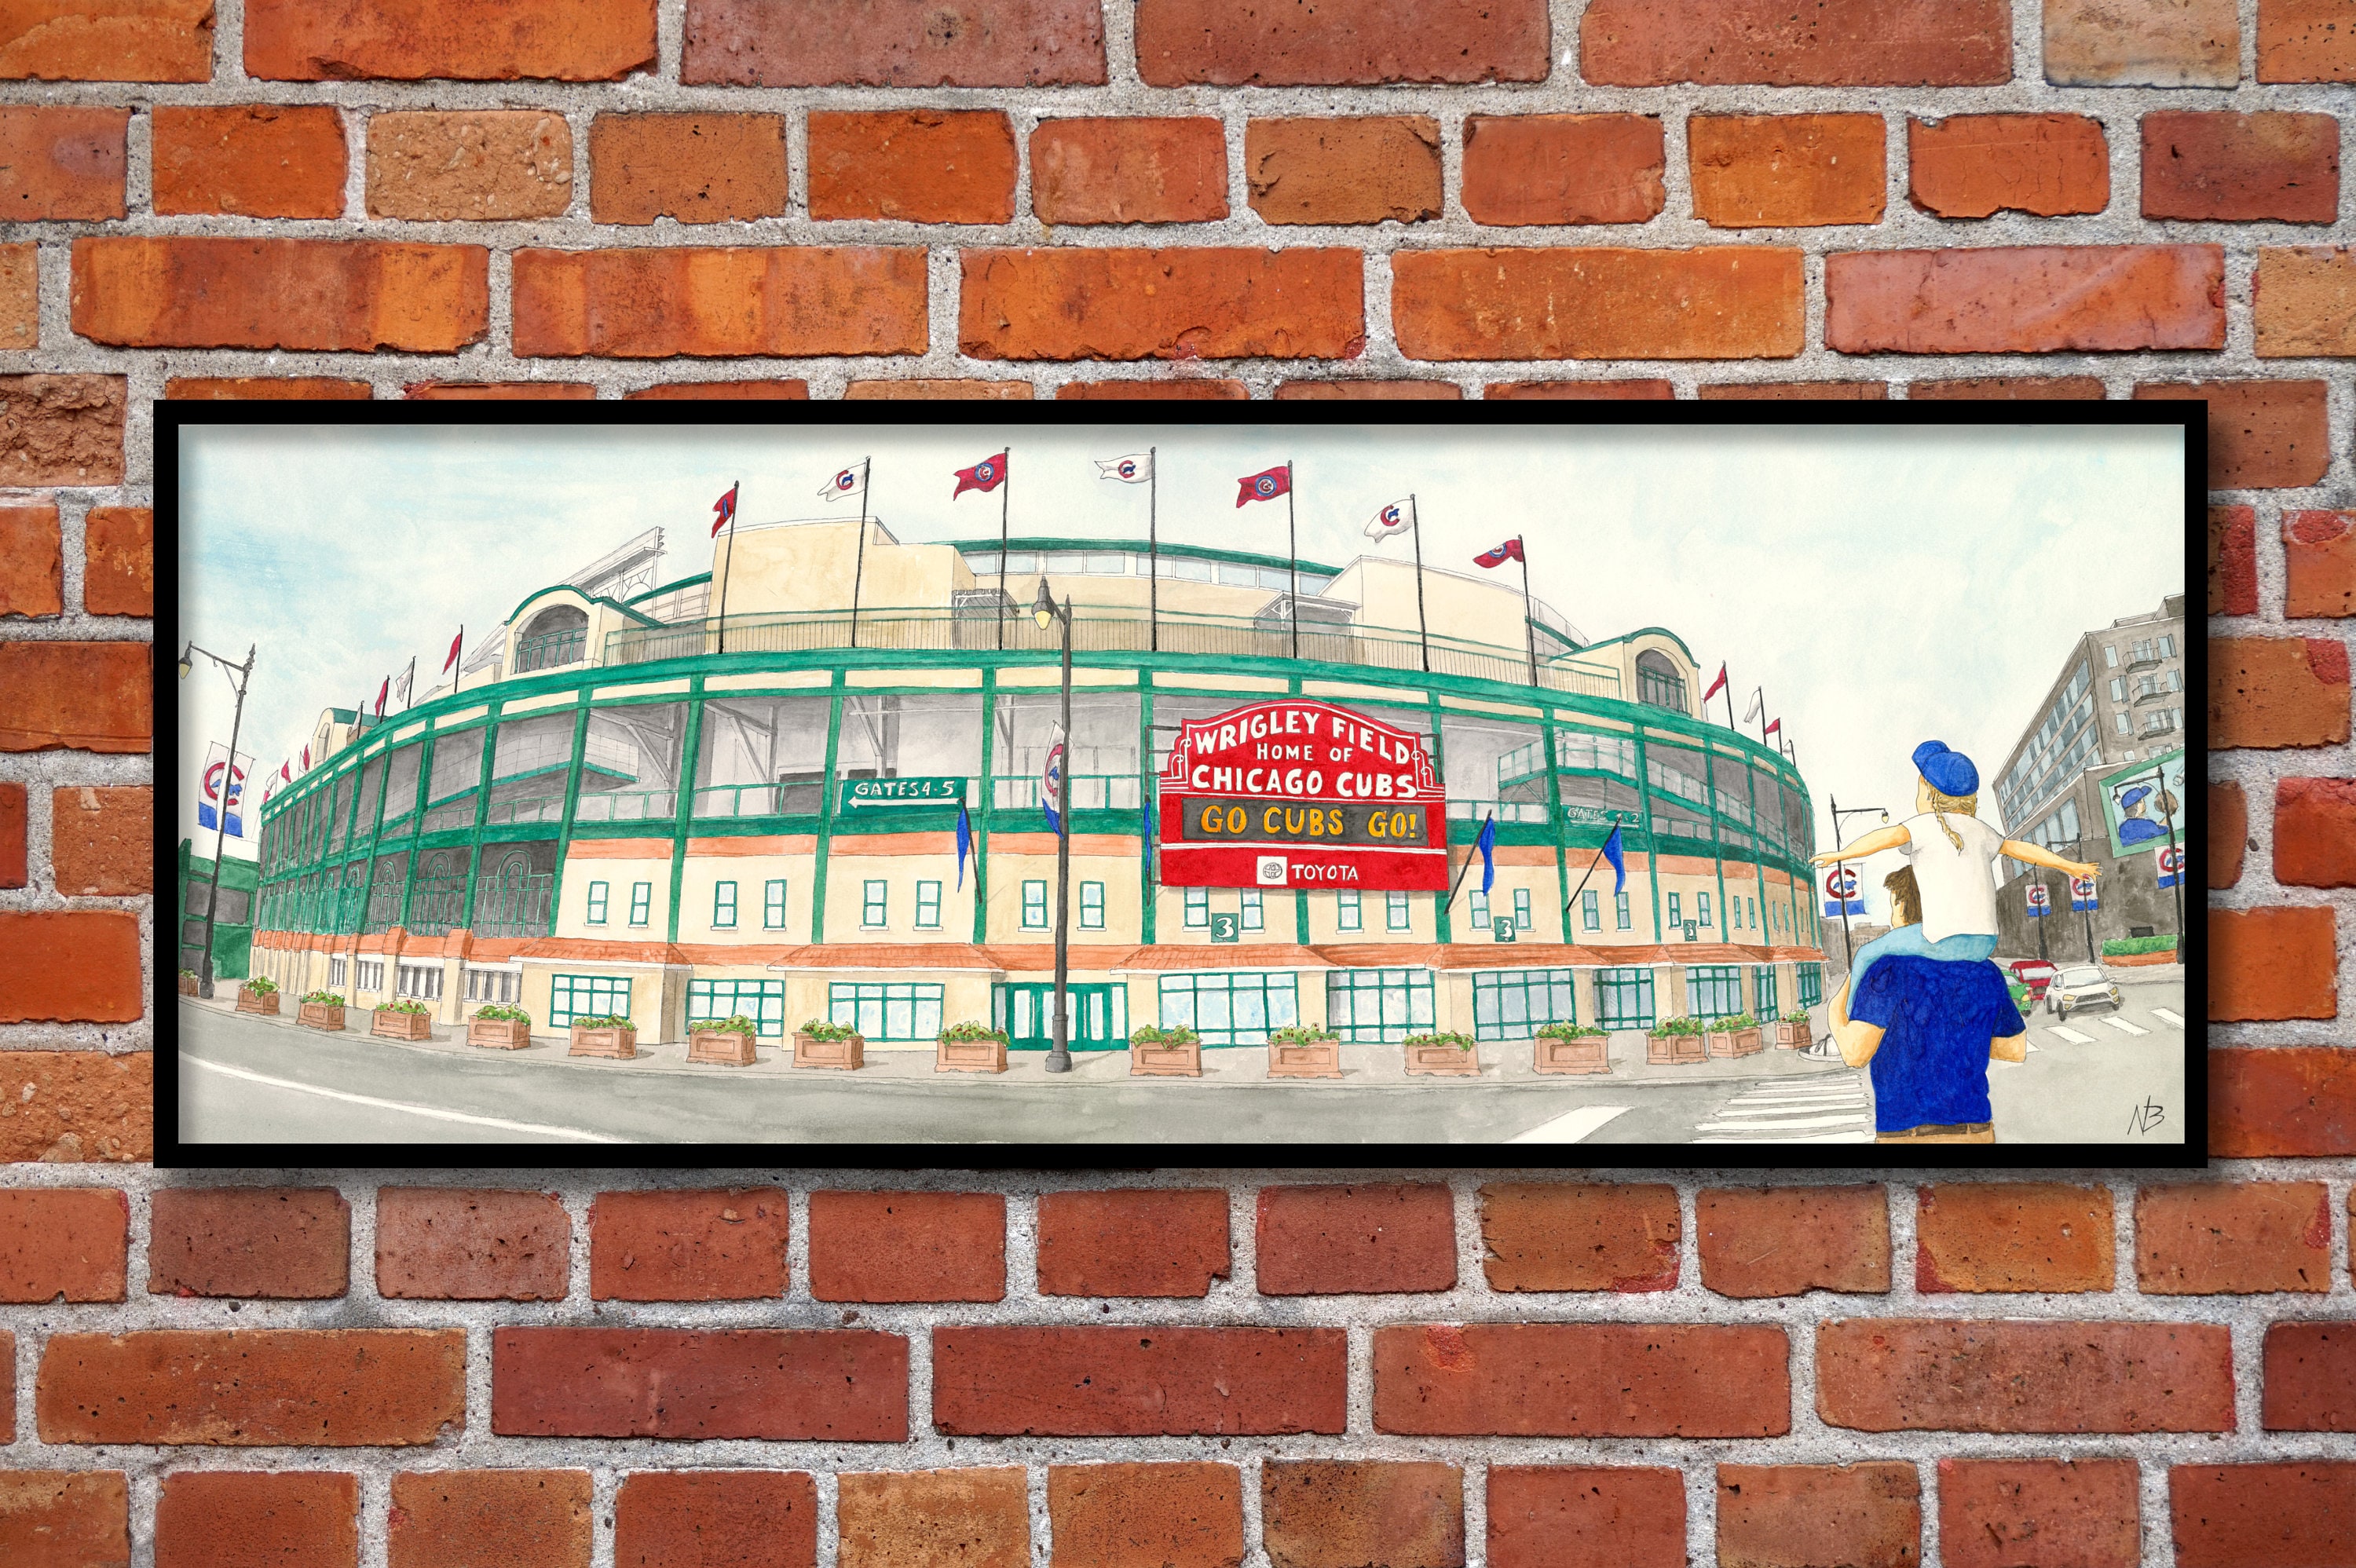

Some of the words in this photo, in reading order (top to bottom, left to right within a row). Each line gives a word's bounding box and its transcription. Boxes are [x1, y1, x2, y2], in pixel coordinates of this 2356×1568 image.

[1194, 710, 1320, 755] WRIGLEY
[1332, 717, 1410, 765] FIELD
[1257, 743, 1313, 761] HOME
[1330, 747, 1353, 762] OF
[854, 781, 919, 796] GATES
[1191, 764, 1323, 795] CHICAGO
[1336, 772, 1417, 799] CUBS
[1202, 805, 1246, 833] GO
[1263, 806, 1344, 835] CUBS
[1368, 810, 1417, 838] GO!
[1568, 807, 1608, 822] GATES
[1291, 864, 1359, 881] TOYOTA
[1216, 917, 1235, 938] 3
[1500, 919, 1513, 938] 3
